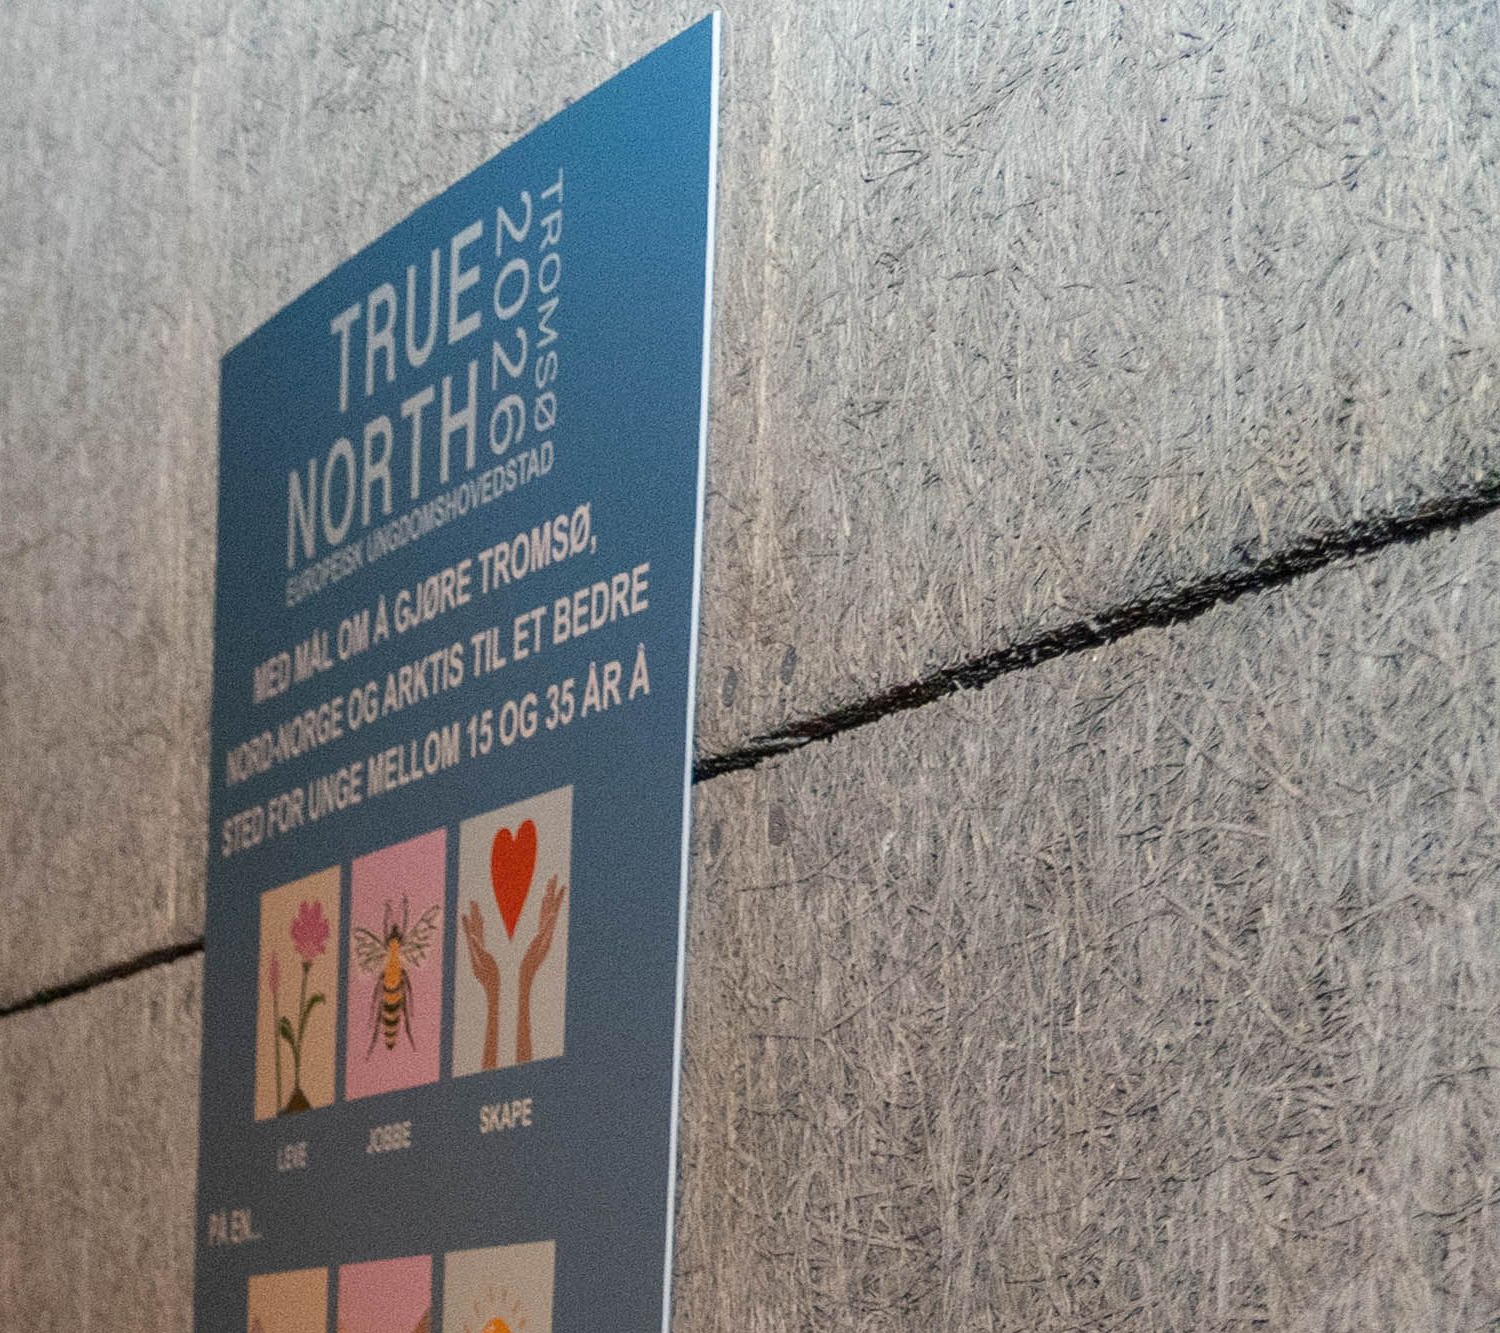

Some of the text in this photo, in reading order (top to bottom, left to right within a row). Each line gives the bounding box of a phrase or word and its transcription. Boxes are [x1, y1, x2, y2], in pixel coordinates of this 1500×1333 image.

[329, 219, 484, 413] TRUE
[488, 190, 533, 456] 2026
[533, 166, 564, 433] TROMSØ
[285, 440, 554, 608] EUROPEISK UNGDOMSHOVEDSTAD
[286, 360, 478, 569] NORTH
[225, 562, 651, 787] NORD-NORGE OG ARKTIS TIL ET BEDRE
[252, 502, 597, 704] MED MÅL OM Å GJØRE TROMSØ,
[221, 642, 651, 857] STED FOR UNGE MELLOM 15 OG 35 ÅR Å
[479, 1098, 533, 1135] SKAPE
